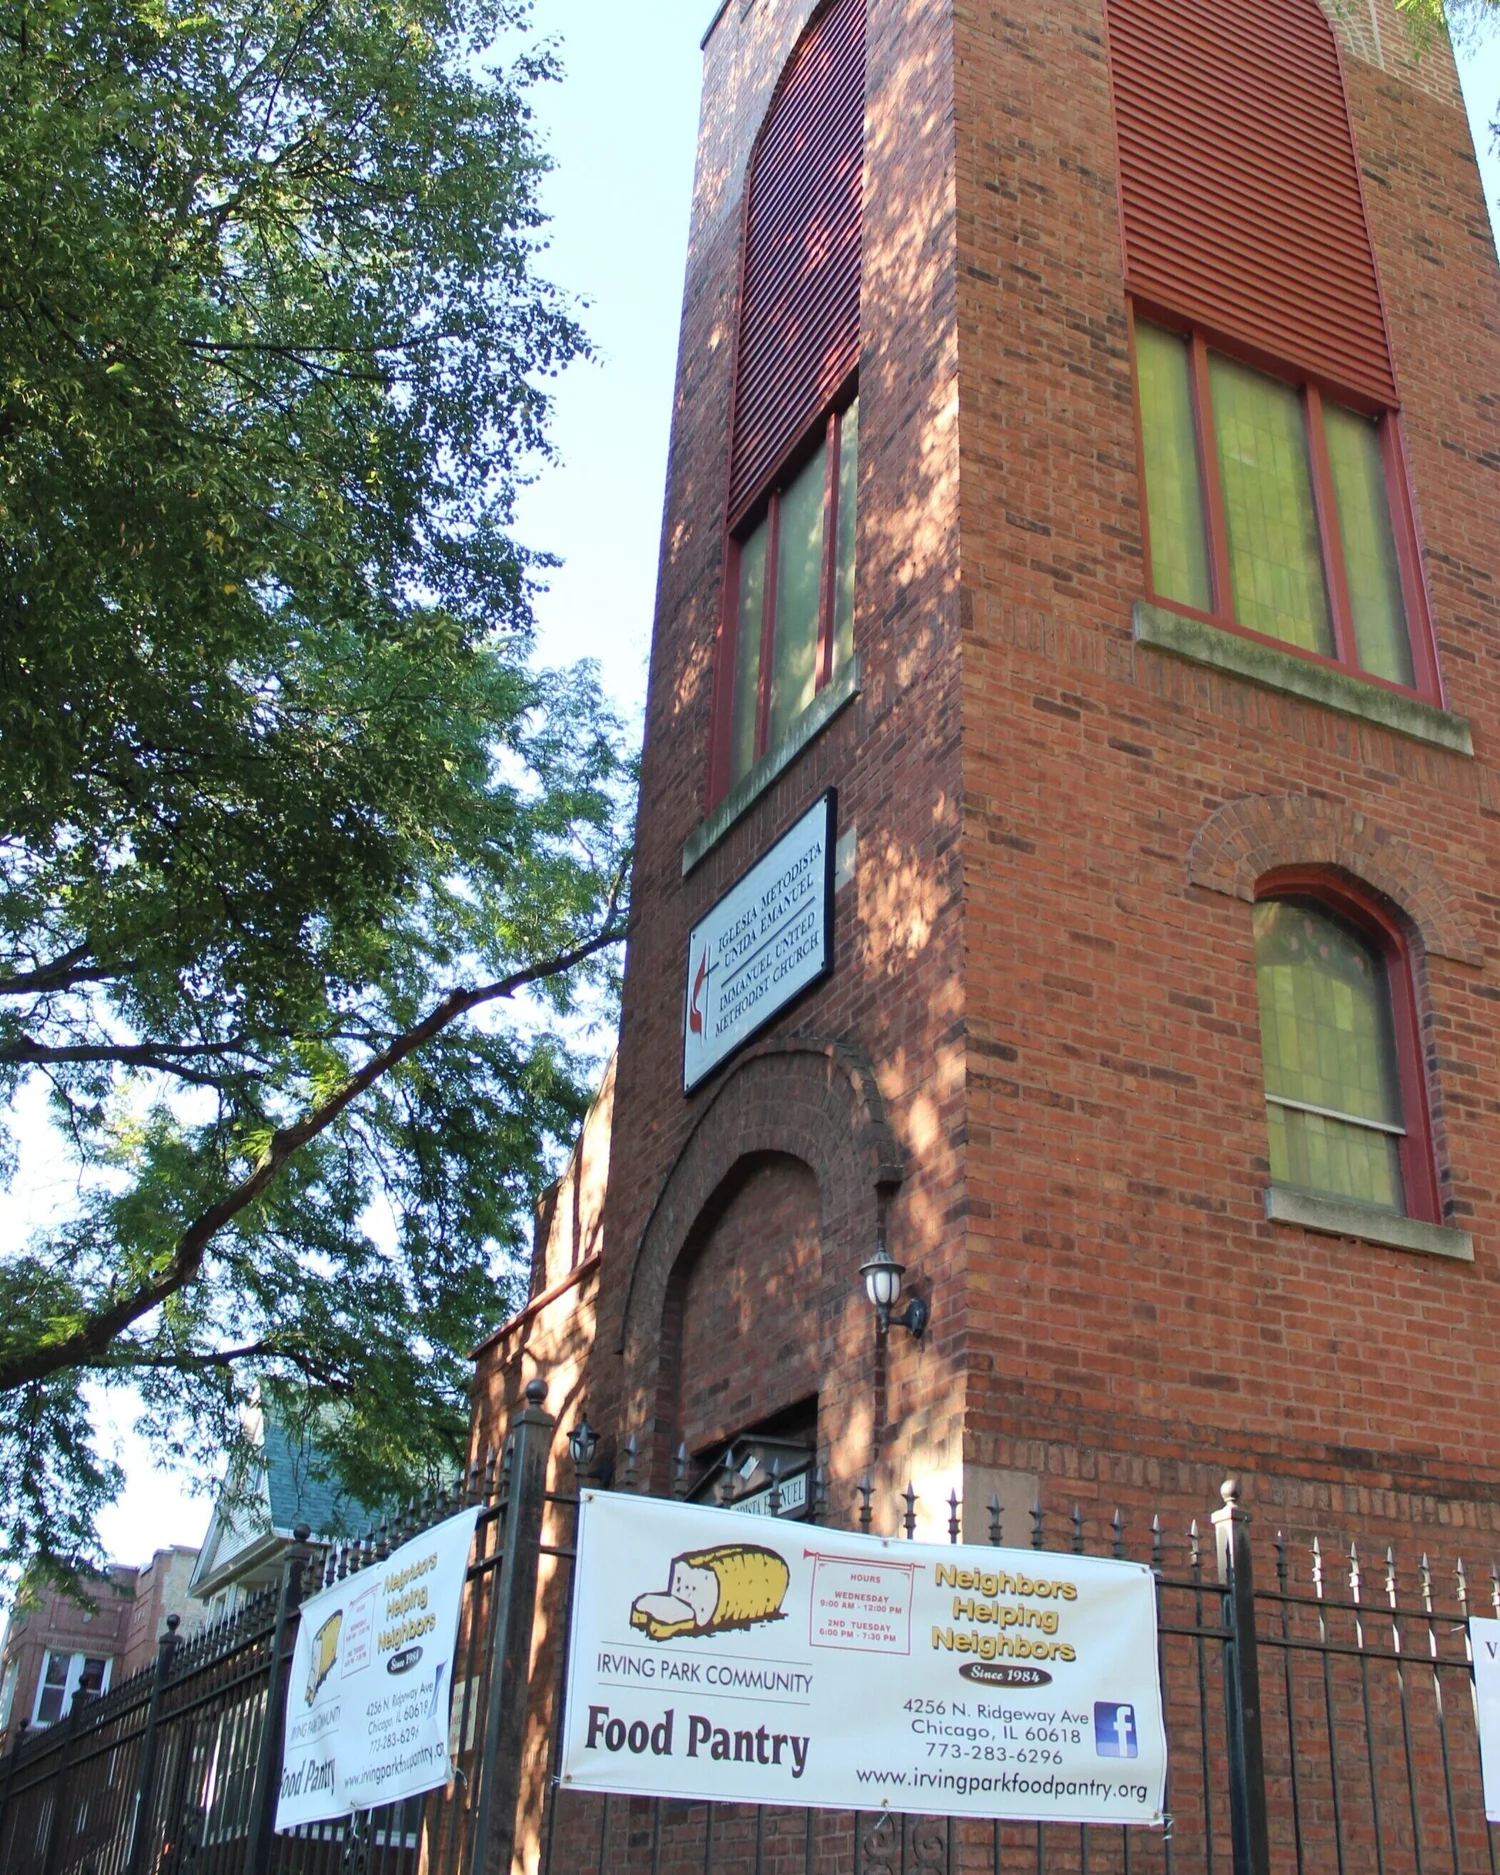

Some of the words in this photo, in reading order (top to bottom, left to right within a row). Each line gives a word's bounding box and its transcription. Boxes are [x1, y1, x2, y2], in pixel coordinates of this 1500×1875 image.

[718, 908, 757, 953] IGLESIA
[761, 840, 821, 912] METODISTA
[724, 930, 757, 968] UNIDA
[760, 872, 814, 937] EMANUEL
[719, 955, 772, 1012] IMMANUEL
[775, 911, 815, 958] UNITED
[715, 975, 770, 1037] METHODIST
[773, 931, 819, 984] CHURCH
[763, 1481, 803, 1515] ENUEL
[383, 1551, 437, 1597] Neighbors
[850, 1573, 881, 1584] HOURS
[935, 1562, 1078, 1601] Neighbors
[386, 1584, 428, 1622] Helping
[820, 1599, 839, 1607] 9:00
[841, 1602, 855, 1610] AM
[863, 1604, 887, 1613] 12:00
[889, 1606, 902, 1614] PM
[834, 1591, 890, 1603] WEDNESDAY
[377, 1612, 436, 1655] Neighbors
[828, 1619, 846, 1628] 2ND
[851, 1621, 891, 1633] TUESDAY
[953, 1597, 1060, 1635] Helping
[819, 1628, 838, 1637] 6:00
[840, 1630, 854, 1638] PM
[862, 1632, 881, 1641] 7:30
[883, 1634, 896, 1642] PM
[931, 1626, 1077, 1661] Neighbors
[391, 1656, 405, 1671] Since
[597, 1653, 655, 1678] IRVING
[660, 1660, 701, 1683] PARK
[706, 1665, 814, 1693] COMMUNITY
[970, 1664, 1004, 1682] Since
[1006, 1668, 1041, 1684] 1984
[366, 1699, 382, 1717] 4256
[419, 1682, 433, 1695] Ave
[903, 1699, 946, 1716] 4256
[953, 1702, 972, 1717] N.
[977, 1704, 1056, 1726] Ridgeway
[1060, 1707, 1089, 1725] Ave
[396, 1711, 401, 1724] IL
[912, 1719, 996, 1741] Chicago,
[1003, 1726, 1019, 1740] IL
[1025, 1727, 1082, 1744] 60618
[585, 1705, 674, 1756] Food
[686, 1715, 810, 1779] Pantry
[925, 1743, 1064, 1765] 773-283-6296
[304, 1758, 335, 1797] Pantry
[856, 1767, 1148, 1803] www.irvingparkfoodpantry.org
